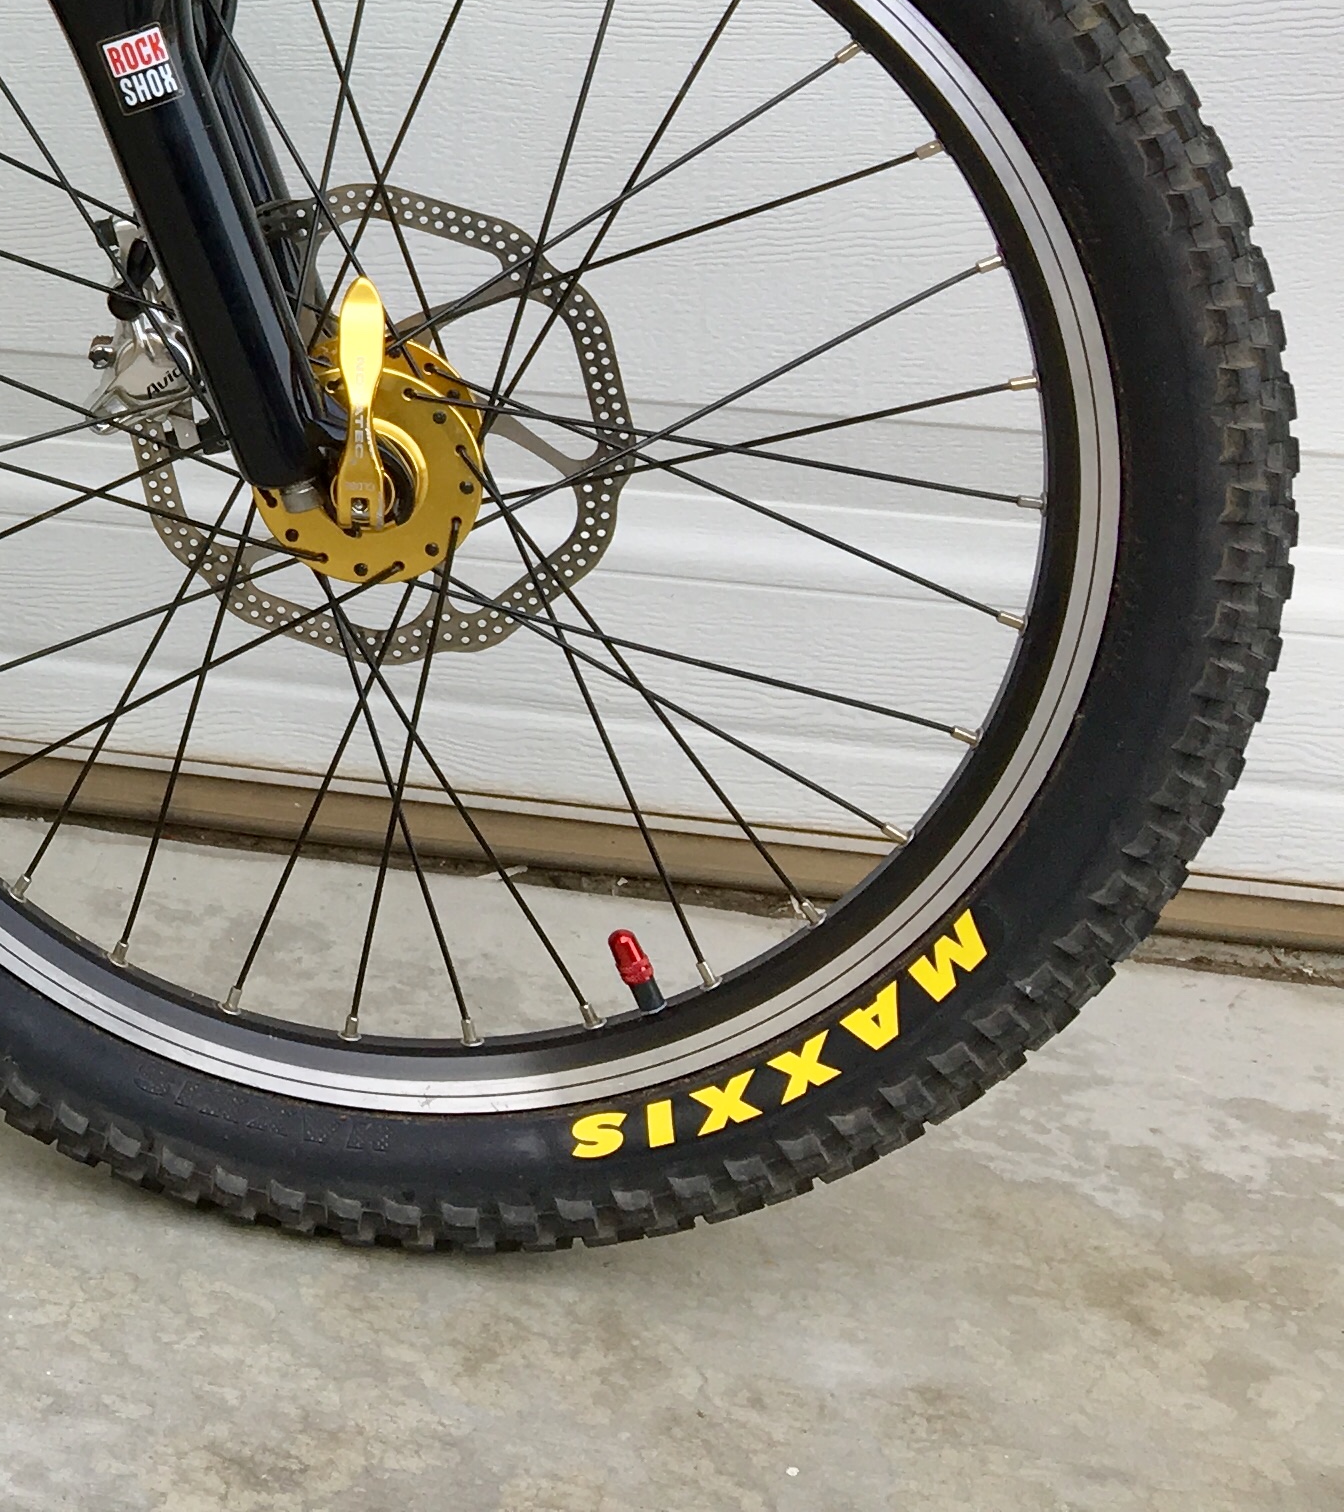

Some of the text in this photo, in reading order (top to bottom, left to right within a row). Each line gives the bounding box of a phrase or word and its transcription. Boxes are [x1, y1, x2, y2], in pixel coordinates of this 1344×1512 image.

[106, 31, 167, 76] ROCK
[119, 62, 179, 107] SHOX
[571, 908, 988, 1159] MAXXIS
